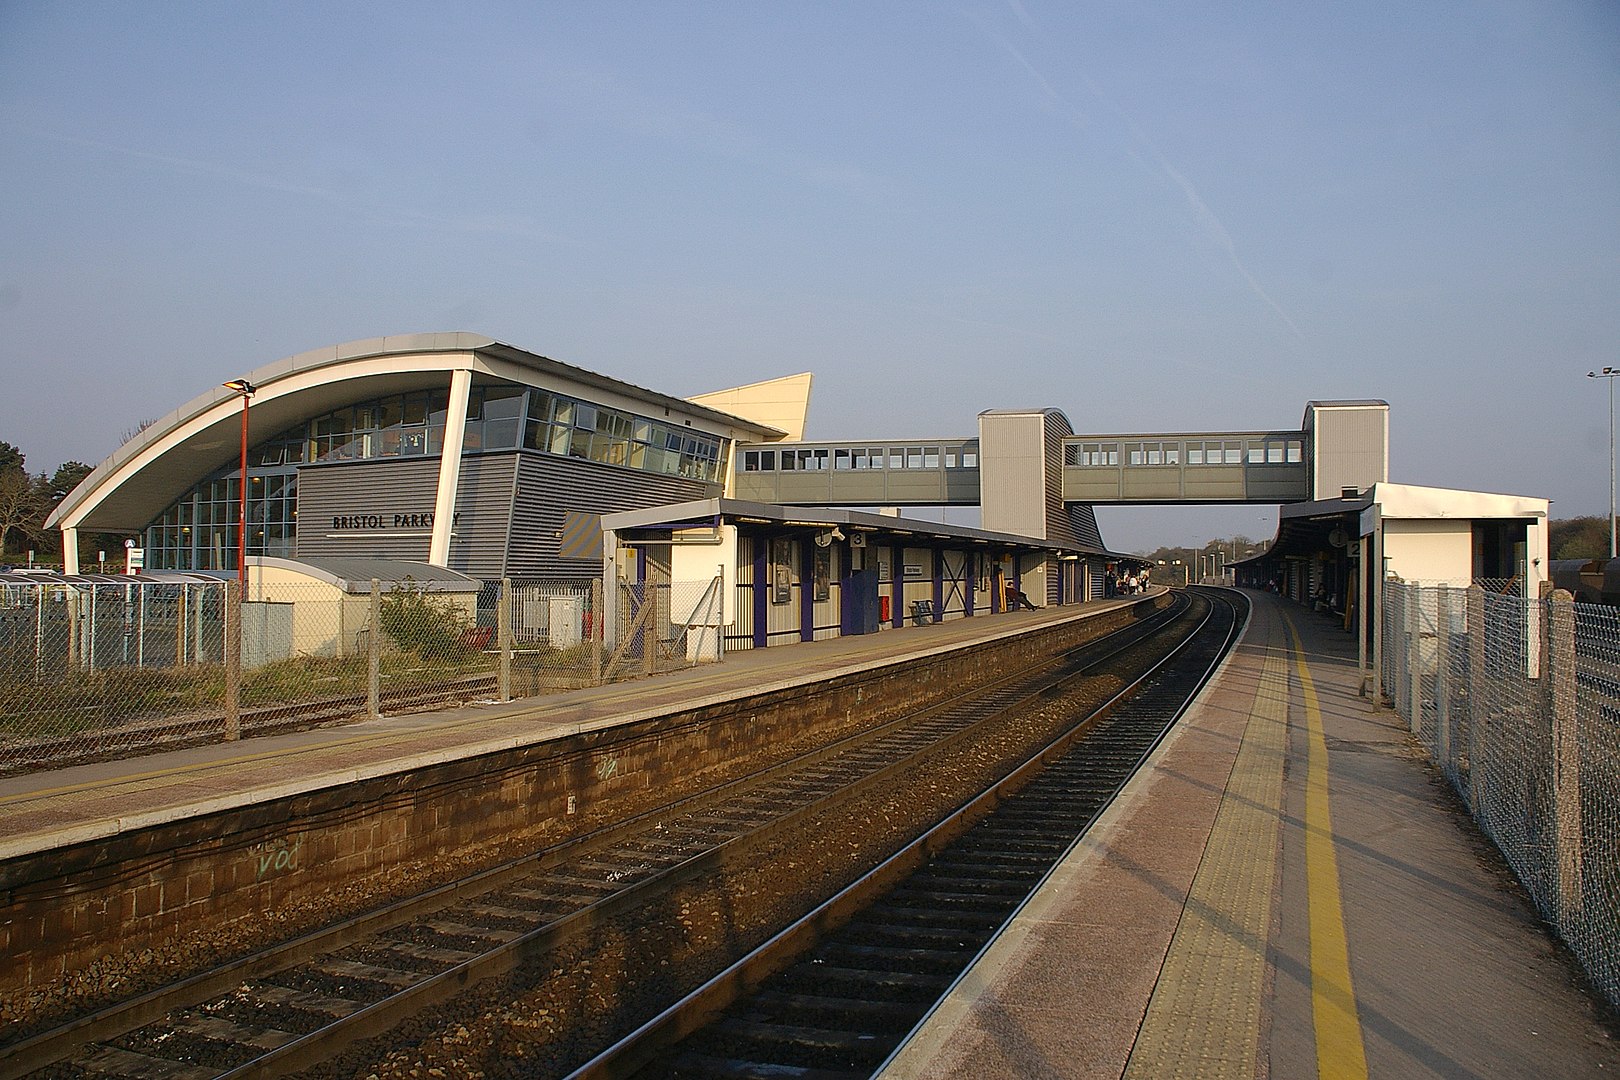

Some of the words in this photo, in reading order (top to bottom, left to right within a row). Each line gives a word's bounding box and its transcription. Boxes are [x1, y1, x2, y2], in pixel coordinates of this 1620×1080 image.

[333, 515, 386, 530] BRISTOL
[394, 512, 461, 528] PARKY
[854, 533, 862, 545] 3
[1351, 543, 1361, 555] 2
